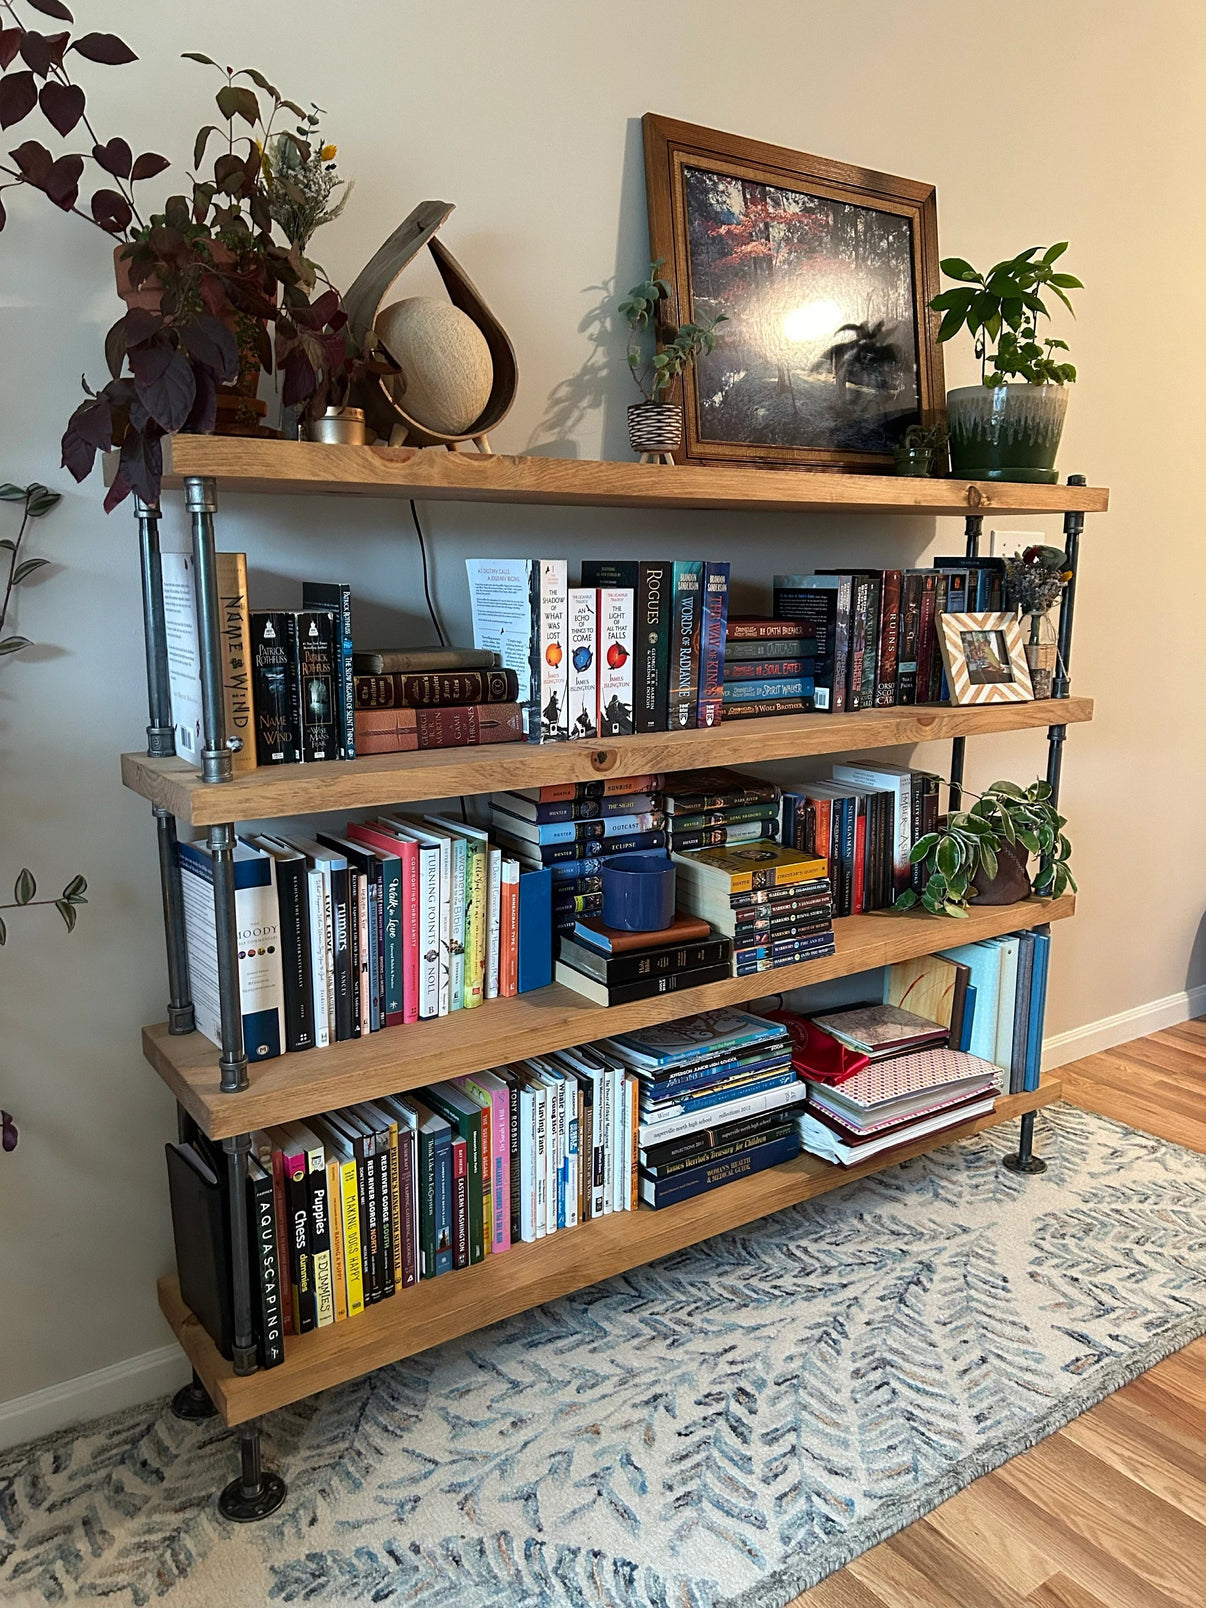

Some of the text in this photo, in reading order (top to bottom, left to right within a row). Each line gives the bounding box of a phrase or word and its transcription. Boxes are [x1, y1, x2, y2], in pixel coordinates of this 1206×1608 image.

[680, 574, 697, 582] BRANDON
[709, 575, 726, 584] BRANDON
[678, 581, 698, 591] SANDERSON
[707, 583, 727, 592] SANDERSON
[647, 568, 662, 624] ROGUES
[220, 596, 246, 652] NAME
[767, 626, 780, 636] OATH
[782, 626, 803, 635] BREAKER
[888, 613, 896, 652] RUINS
[573, 634, 592, 642] COME
[259, 644, 284, 656] PATRICK
[678, 596, 694, 698] WORDS OF RADIANCE
[706, 596, 722, 696] THE WAY KINGS
[767, 642, 798, 655] OUTCAST
[256, 654, 287, 666] ROTHFUSS
[305, 651, 328, 662] PATRICK
[302, 662, 330, 675] ROTHFUSS
[763, 664, 782, 676] SOUL
[783, 663, 802, 674] EATER
[576, 677, 589, 685] JAMES
[609, 674, 624, 682] JAMES
[604, 681, 630, 689] ISLINGTON
[762, 685, 781, 696] SPIRIT
[782, 684, 802, 694] WALKER
[224, 672, 250, 728] WIND
[260, 715, 286, 726] NAME
[346, 710, 354, 726] SILENT
[420, 712, 428, 746] GEORGE
[435, 712, 443, 744] MARTIN
[467, 706, 475, 744] THRONES
[263, 732, 292, 744] WIND
[312, 740, 326, 748] FEAR
[608, 784, 632, 792] SUNRISE
[900, 792, 909, 825] EMBER
[612, 823, 639, 831] OUTCAST
[612, 842, 636, 850] ECLIPSE
[428, 854, 436, 945] TURNING POINTS
[386, 878, 399, 938] Walk Love
[453, 906, 462, 934] Bible
[694, 1064, 708, 1072] JUNIOR
[657, 1111, 670, 1119] West
[718, 1108, 740, 1119] reflections
[654, 1116, 712, 1139] naperville north high school
[722, 1118, 771, 1139] naperville school
[666, 1135, 767, 1174] James Herriot's Treasury for Children
[672, 1144, 695, 1155] REFLECTIONS
[391, 1147, 399, 1189] PREPPER'S
[731, 1157, 751, 1169] HEALTH
[429, 1173, 434, 1181] An
[712, 1164, 751, 1182] MEDICAL GUIDE
[312, 1189, 327, 1235] Puppies
[295, 1210, 307, 1249] Chess
[347, 1195, 360, 1282] MAKING DOGS HAPPY
[260, 1203, 279, 1340] AQUASCAPING
[300, 1254, 308, 1292] dummies
[318, 1260, 330, 1312] DUMMIES
